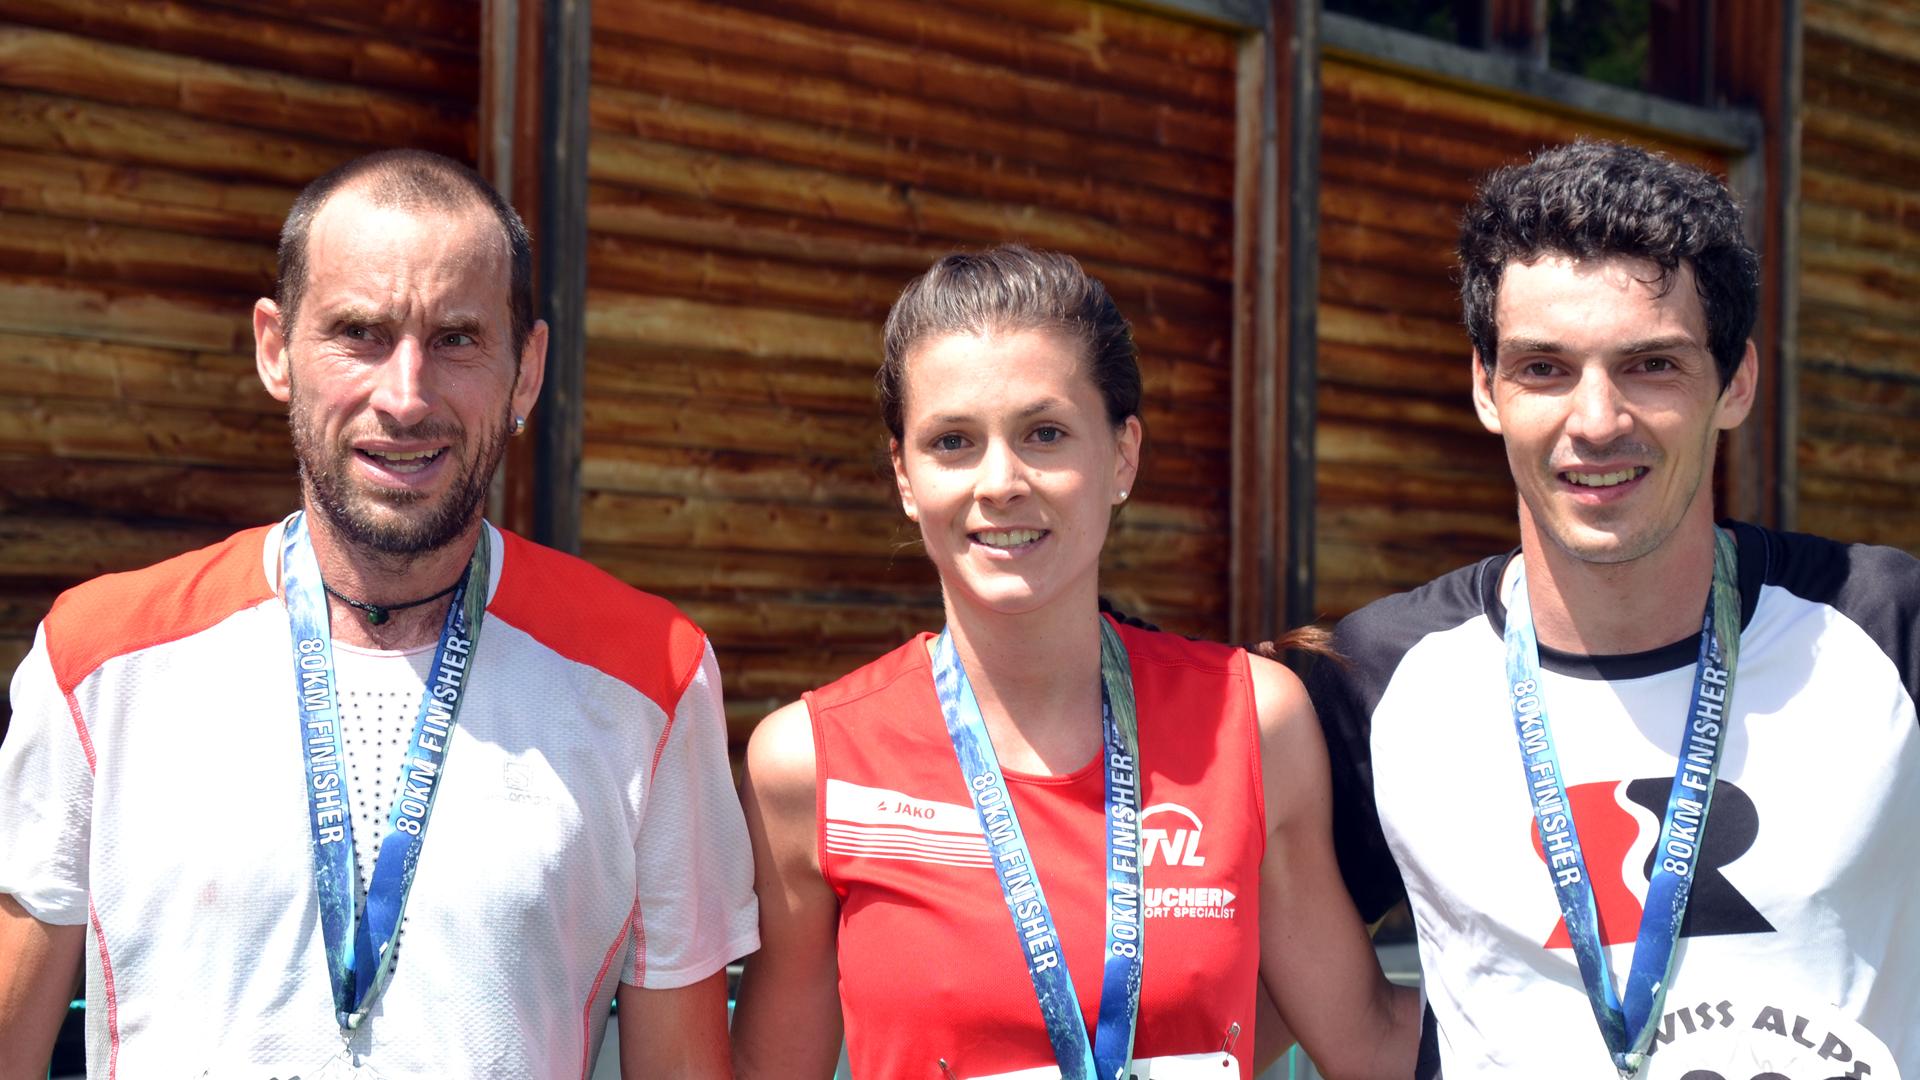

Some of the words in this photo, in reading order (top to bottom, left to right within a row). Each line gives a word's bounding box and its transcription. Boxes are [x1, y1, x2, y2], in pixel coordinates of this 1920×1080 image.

[299, 637, 332, 711] 80KM
[396, 754, 438, 836] 80KM
[418, 635, 472, 752] FINISHER
[1513, 678, 1549, 755] 80KM
[1682, 666, 1728, 791] FINISHER
[307, 719, 345, 845] FINISHER
[895, 802, 935, 819] JAKO
[1110, 751, 1136, 874] FINISHER
[1530, 762, 1581, 887] FINISHER
[1663, 796, 1702, 876] 80KM
[972, 771, 1017, 847] 80KM
[999, 848, 1058, 973] FINISHER
[1145, 887, 1224, 907] UCHER
[1111, 882, 1137, 959] 80KM
[1145, 908, 1171, 918] ORT
[1174, 907, 1235, 919] SPECIALIST
[1647, 1000, 1735, 1056] WISS
